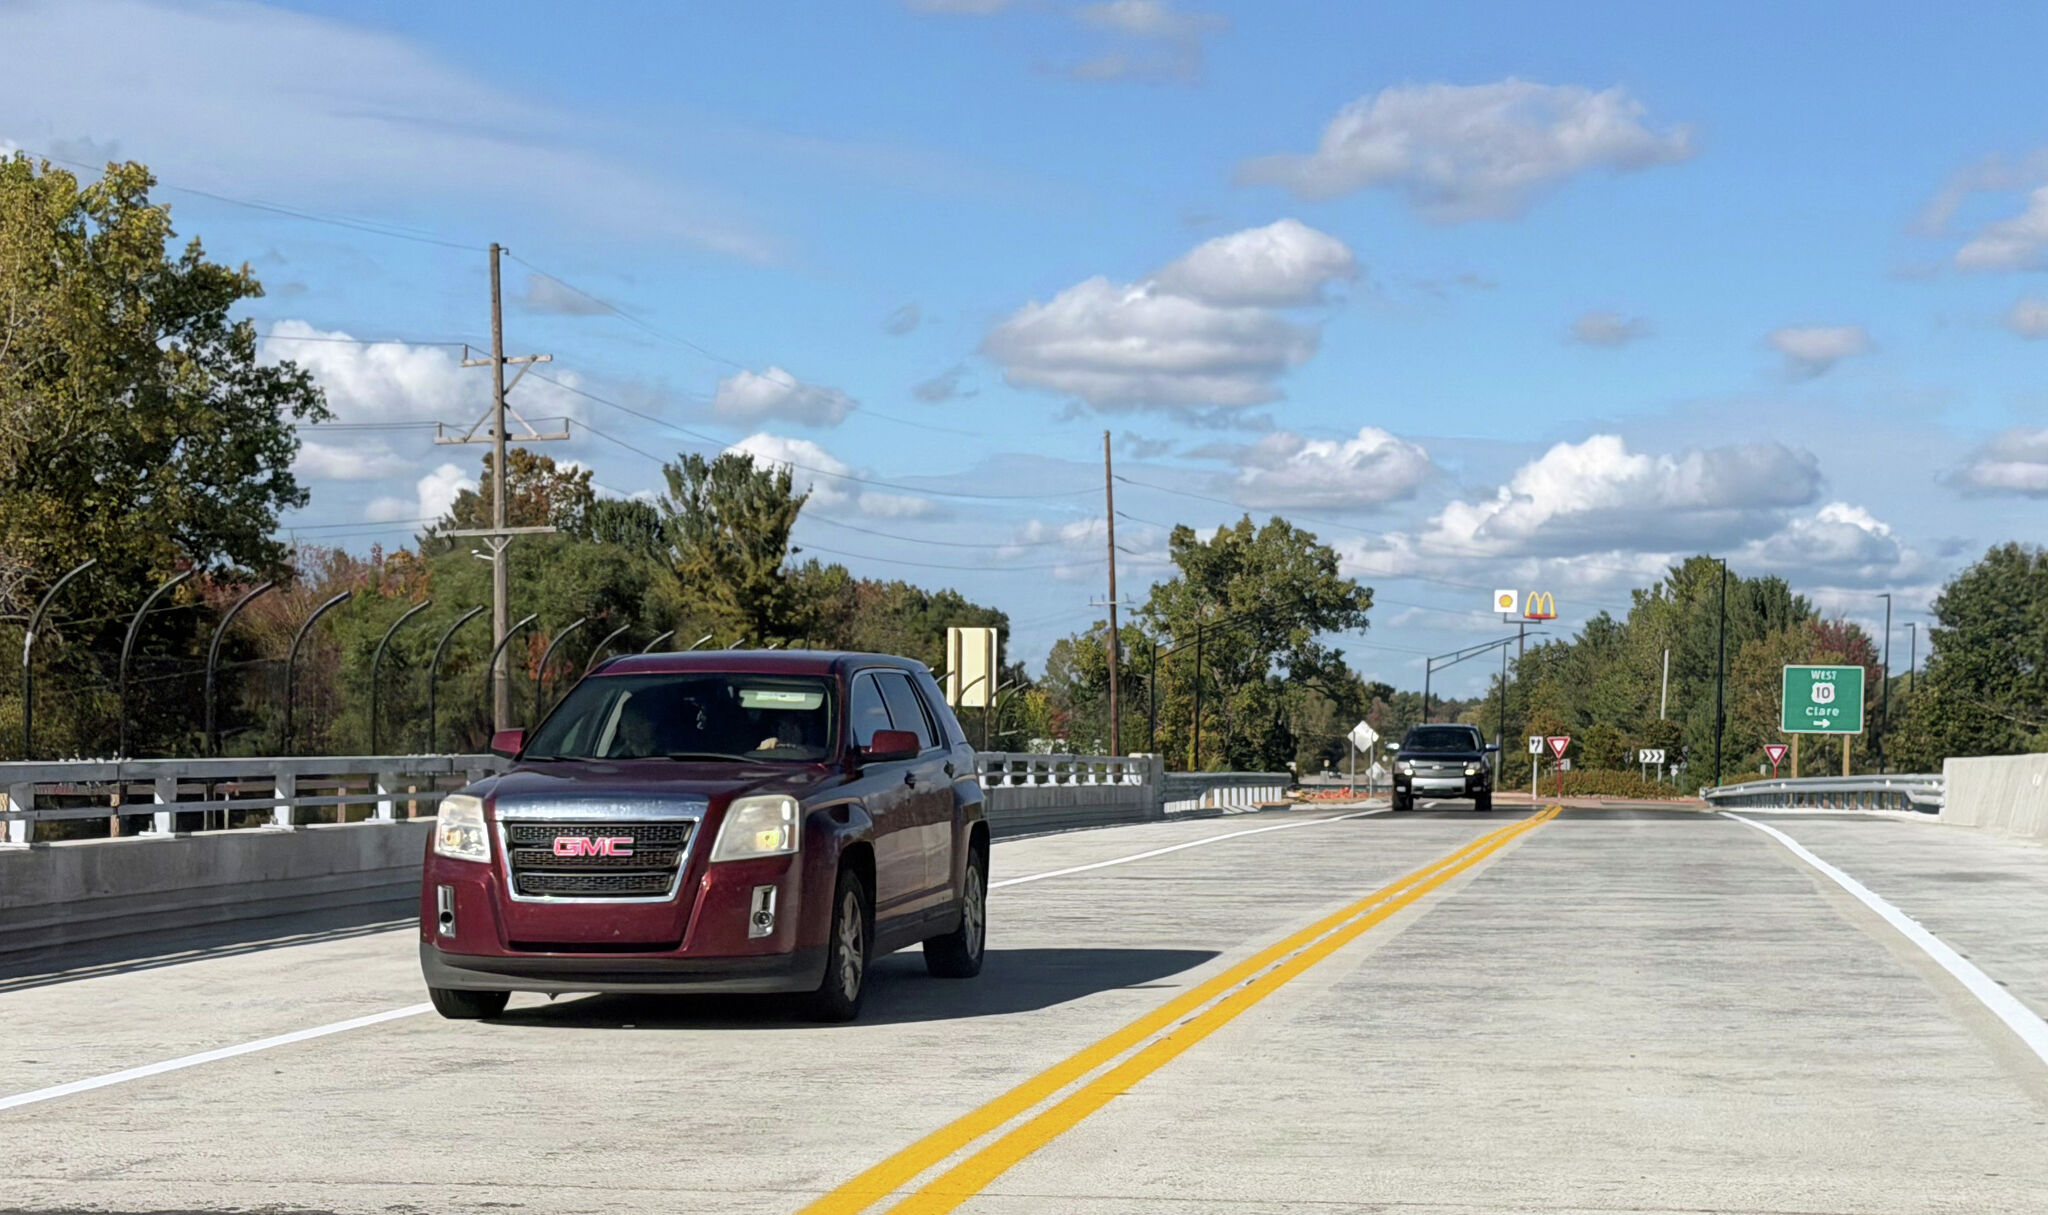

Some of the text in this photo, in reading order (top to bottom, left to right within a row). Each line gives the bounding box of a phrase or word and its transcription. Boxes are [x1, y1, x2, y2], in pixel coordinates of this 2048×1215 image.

[1811, 670, 1837, 680] WEST
[1816, 686, 1831, 699] 10
[1805, 706, 1840, 716] Clare
[553, 836, 634, 856] GMC
